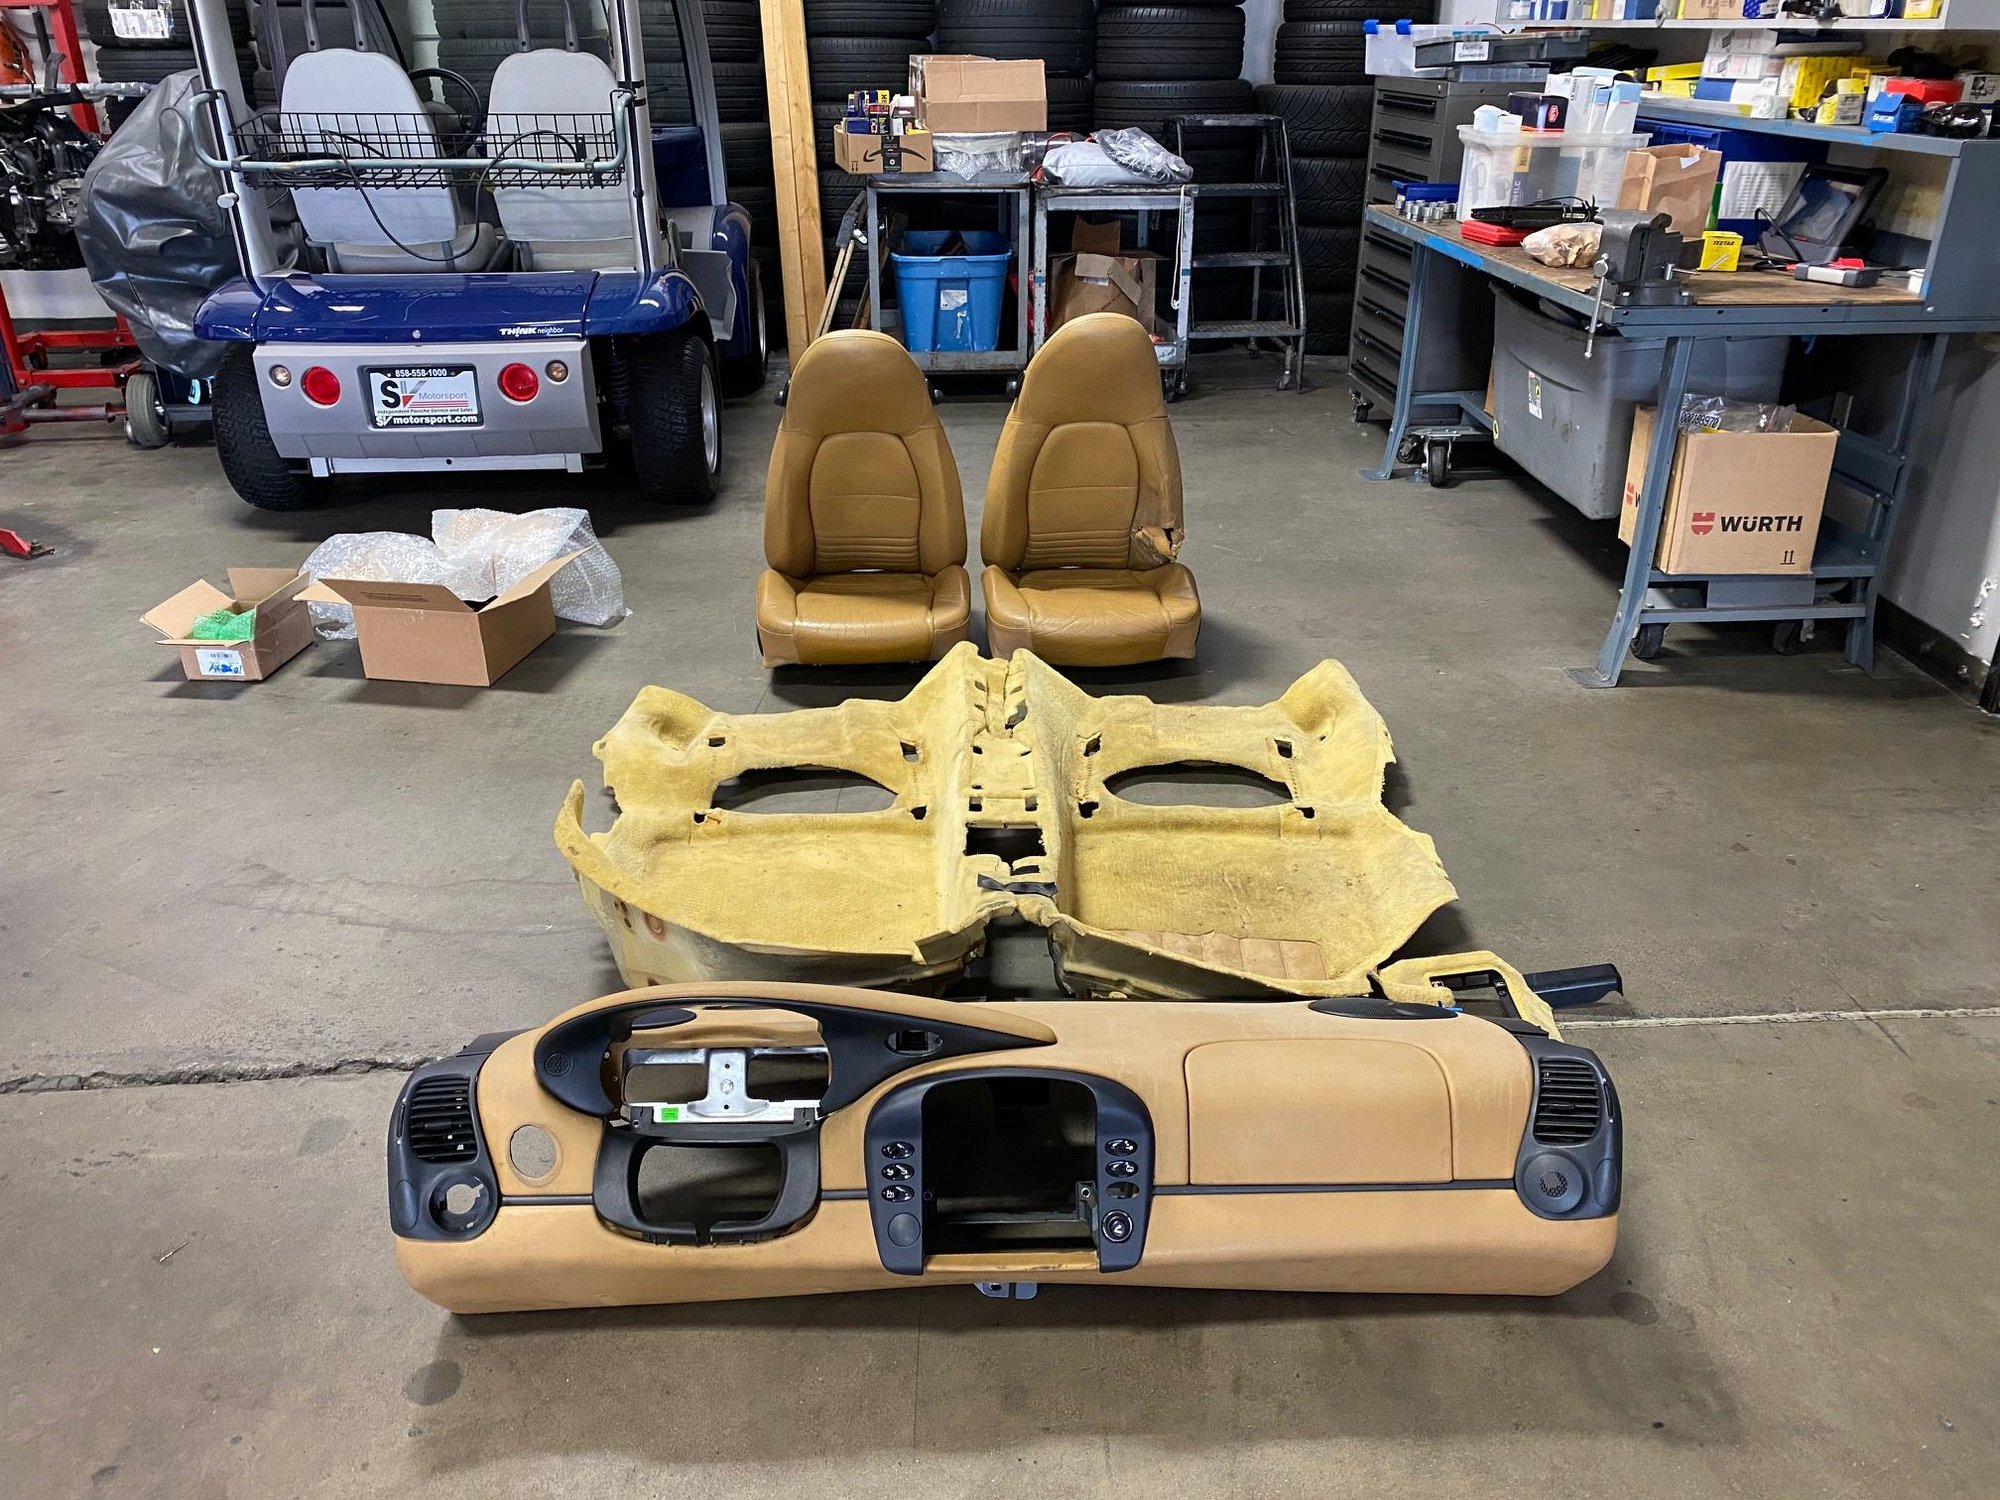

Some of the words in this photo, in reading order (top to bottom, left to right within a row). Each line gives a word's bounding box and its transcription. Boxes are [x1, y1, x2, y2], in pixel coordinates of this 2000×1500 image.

[537, 326, 565, 336] neighbor
[395, 368, 448, 378] 858-558-1000
[419, 392, 468, 401] Motorsport
[393, 415, 478, 425] motorsport.com
[1720, 515, 1803, 533] WÜRTH
